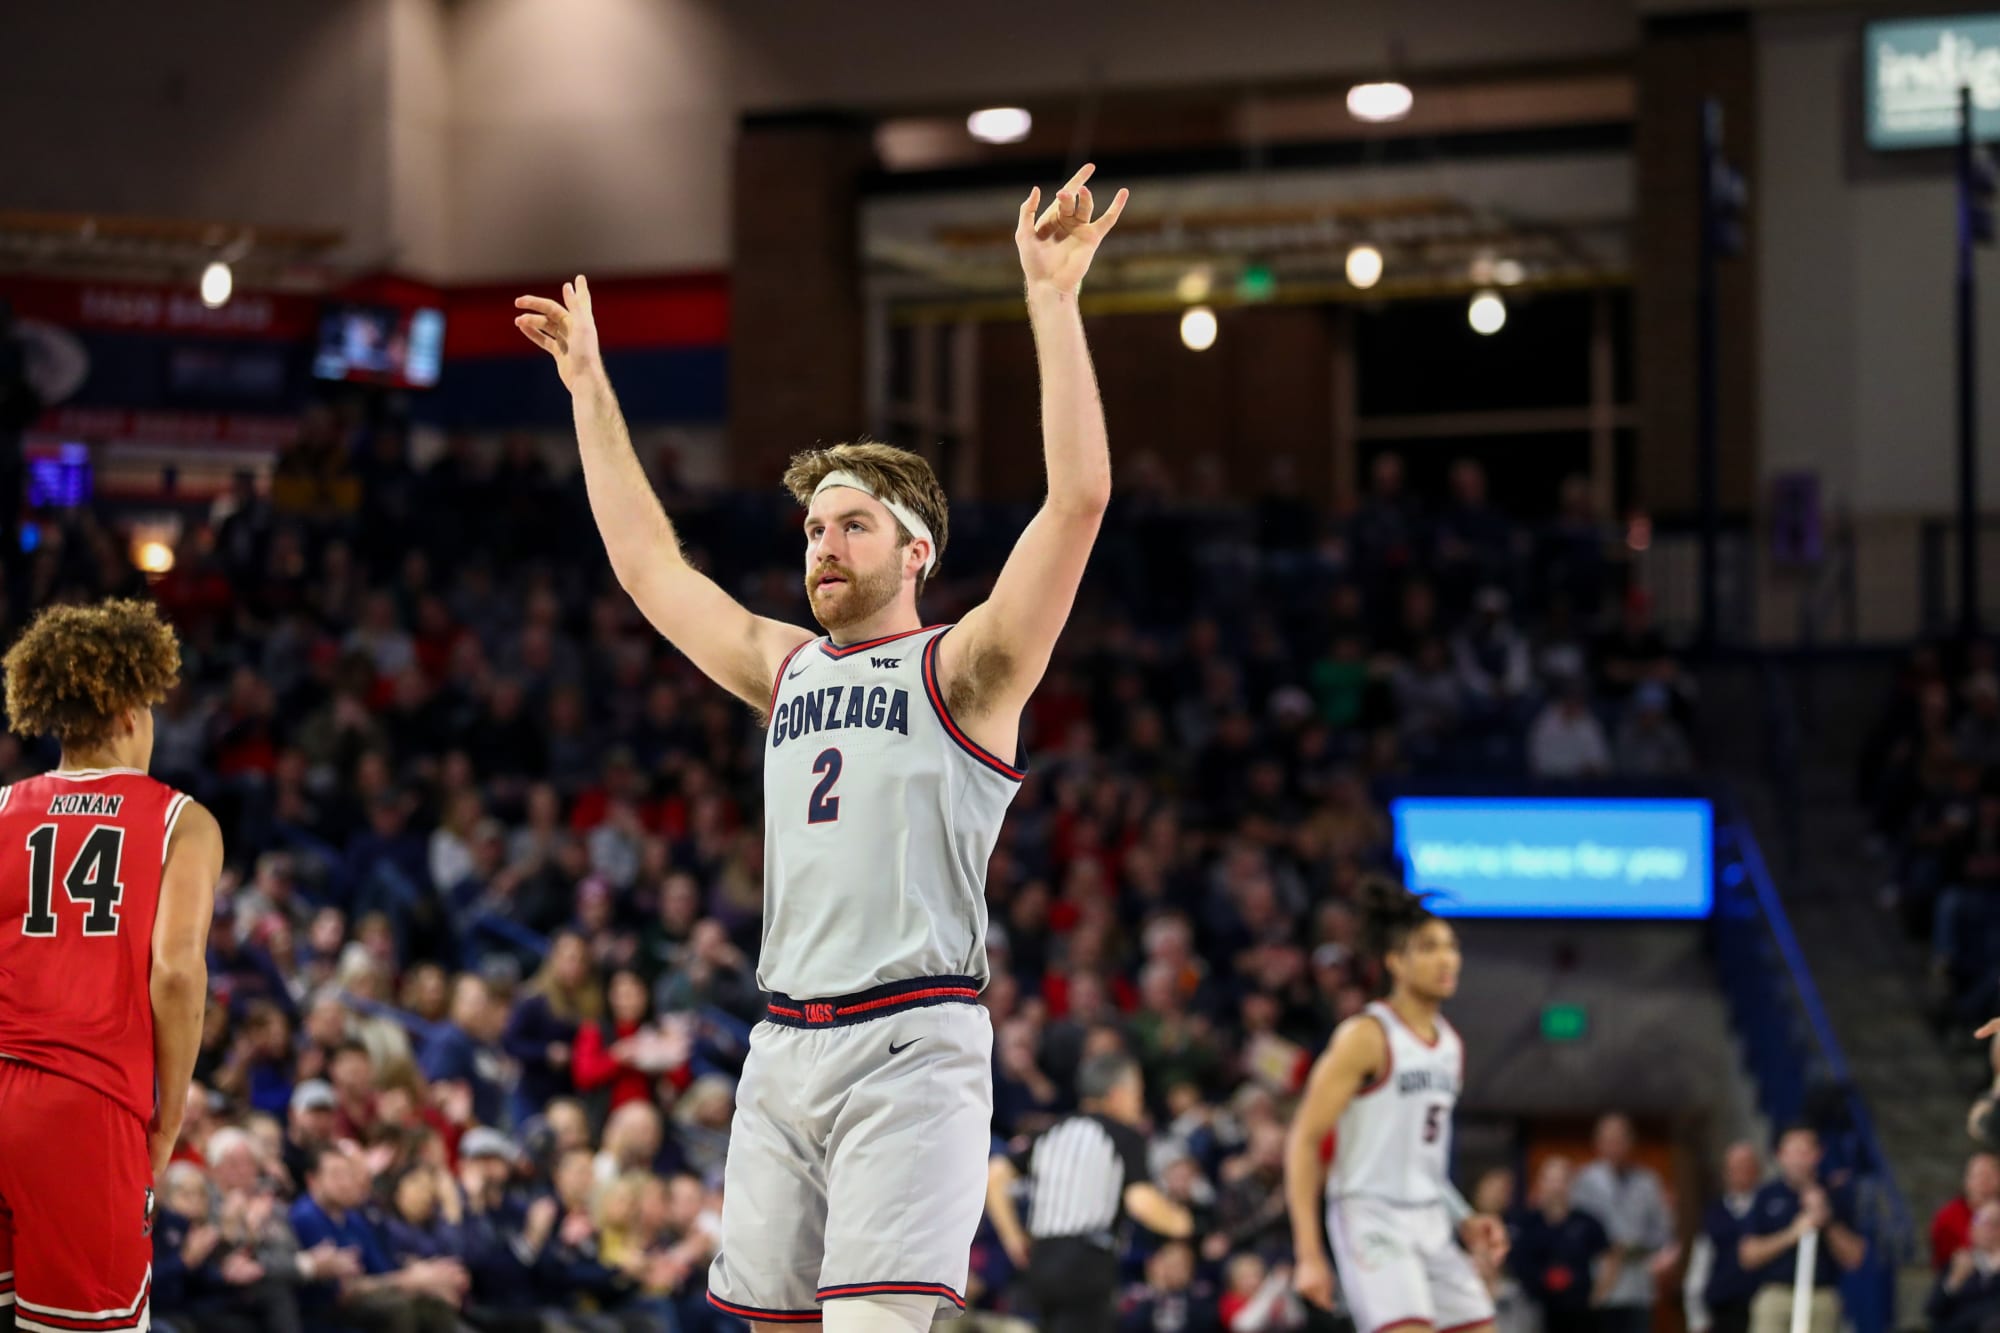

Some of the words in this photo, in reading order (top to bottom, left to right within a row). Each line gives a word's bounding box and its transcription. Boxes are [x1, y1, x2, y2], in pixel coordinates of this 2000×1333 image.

[870, 656, 903, 669] WCC
[773, 686, 909, 748] GONZAGA
[48, 793, 124, 817] KONAN
[807, 747, 843, 825] 2
[21, 823, 125, 937] 14
[804, 1003, 834, 1024] ZAGS
[1422, 1103, 1445, 1143] 5
